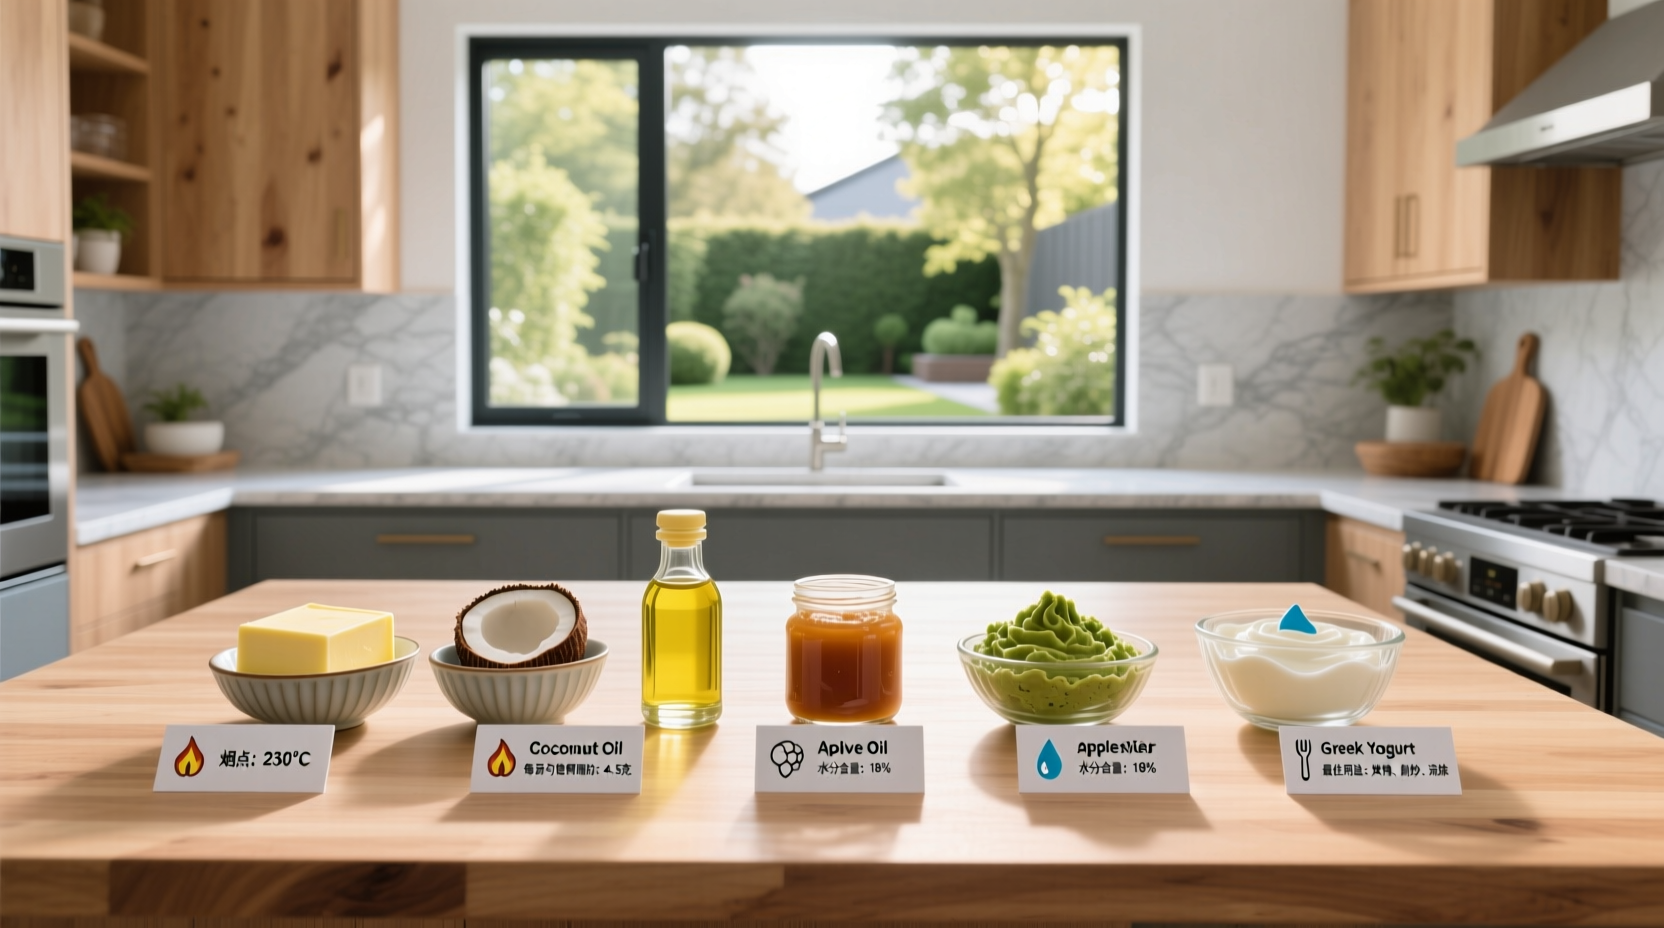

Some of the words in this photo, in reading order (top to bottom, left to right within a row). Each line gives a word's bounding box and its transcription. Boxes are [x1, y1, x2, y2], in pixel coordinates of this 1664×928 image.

[601, 740, 623, 756] Oil
[866, 740, 888, 755] Oil
[1320, 740, 1365, 756] Greek
[1366, 741, 1416, 760] Yogurt
